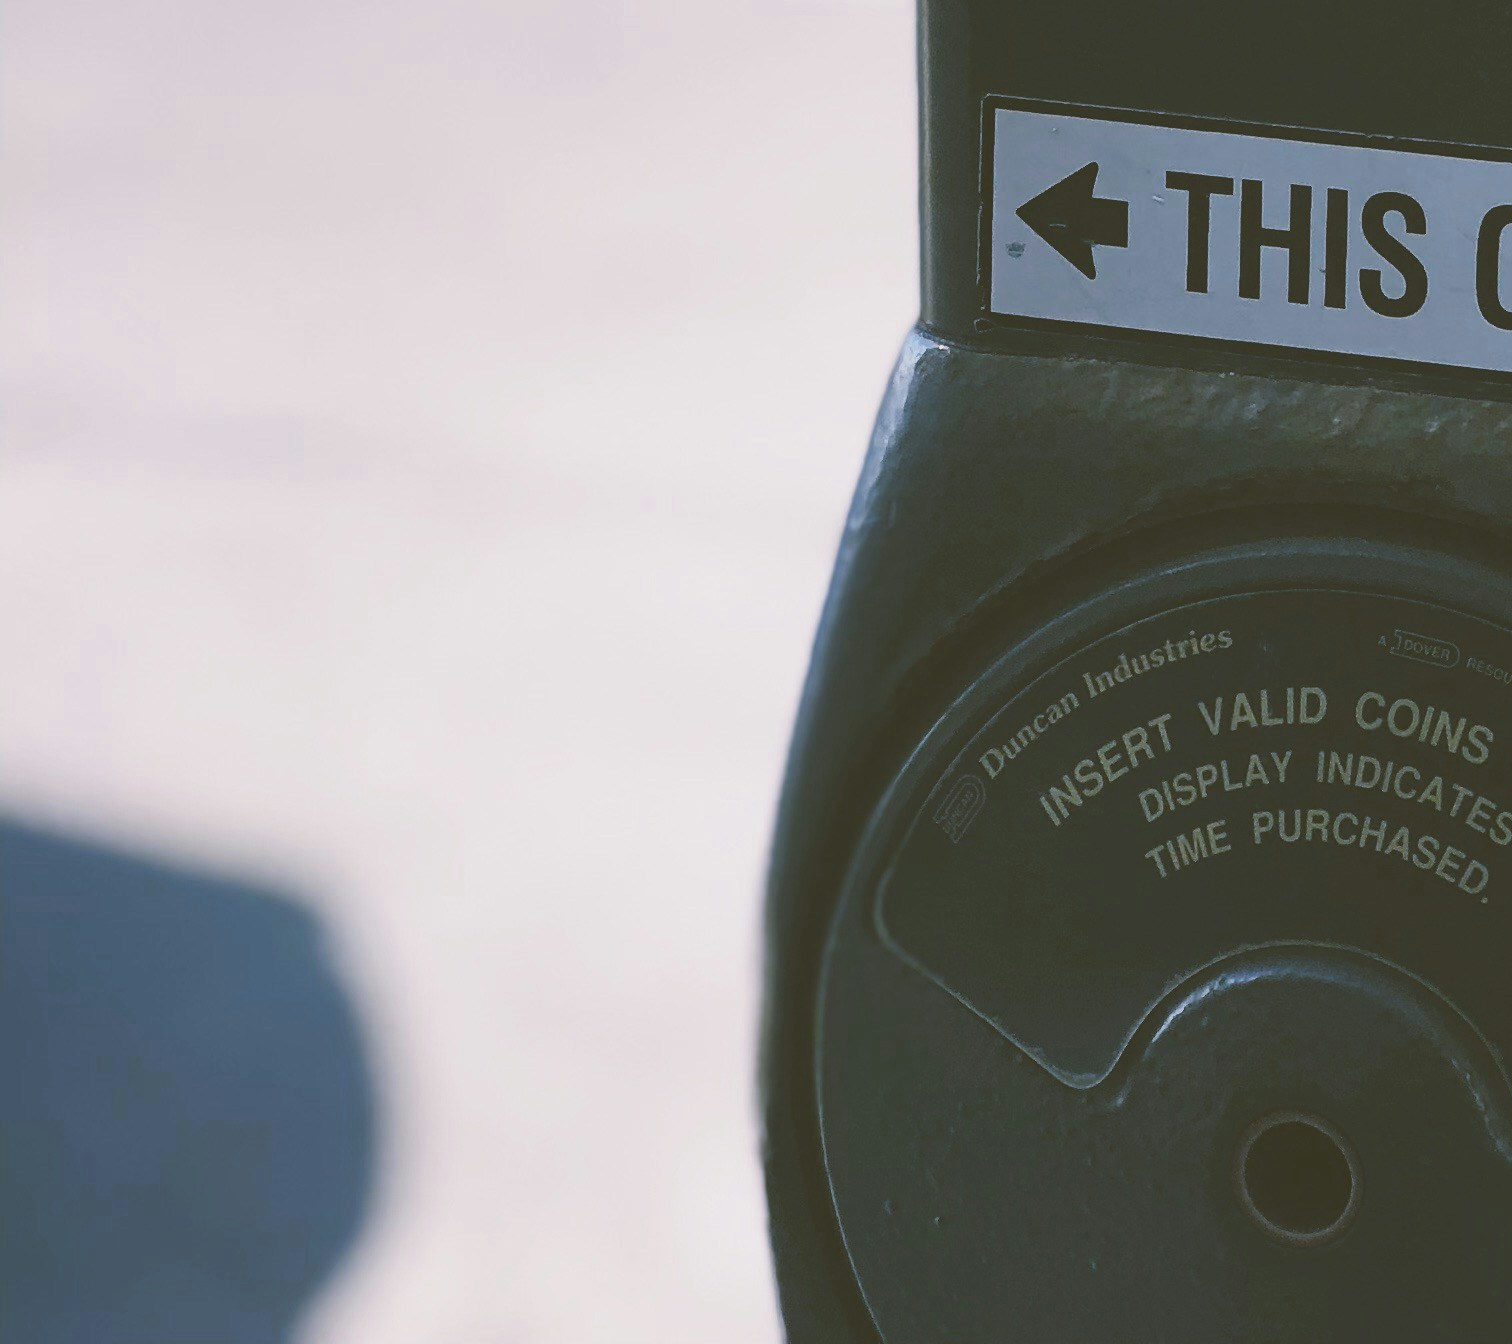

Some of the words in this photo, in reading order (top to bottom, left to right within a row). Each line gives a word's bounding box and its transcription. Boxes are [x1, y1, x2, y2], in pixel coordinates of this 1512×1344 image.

[1165, 170, 1429, 318] THIS
[979, 691, 1079, 779] Duncan
[1082, 630, 1233, 698] Industries
[1377, 635, 1387, 647] A
[1404, 639, 1451, 661] DOVER
[1039, 713, 1172, 827] INSERT
[1197, 687, 1328, 735] VALID
[1355, 691, 1494, 764] COINS
[1137, 750, 1292, 823] DISPLAY
[1144, 820, 1231, 878] TIME
[1252, 809, 1489, 903] PURCHASED.
